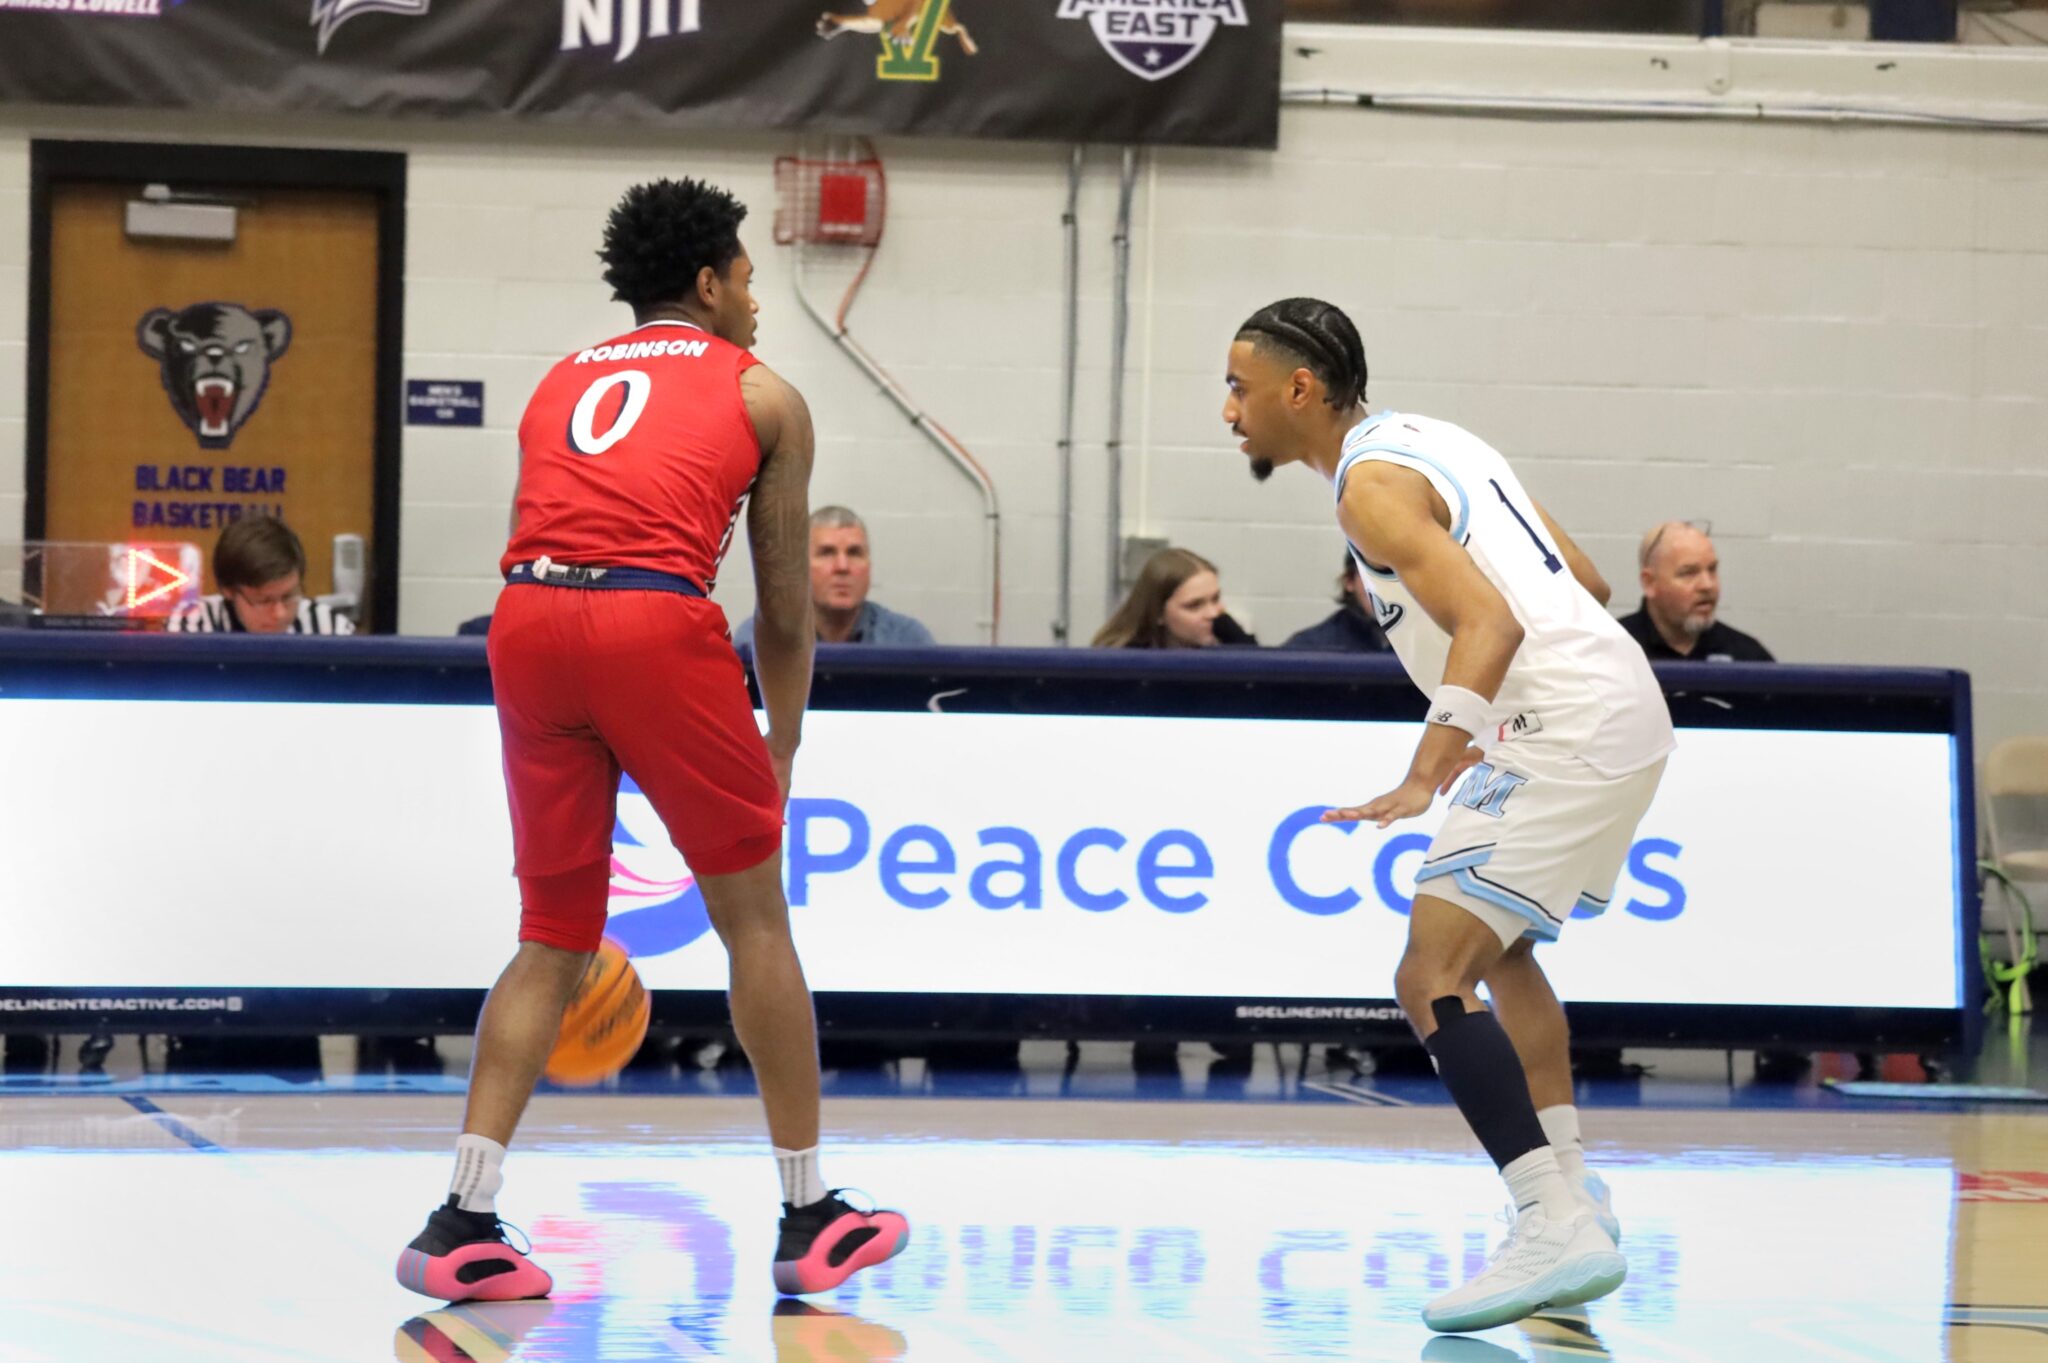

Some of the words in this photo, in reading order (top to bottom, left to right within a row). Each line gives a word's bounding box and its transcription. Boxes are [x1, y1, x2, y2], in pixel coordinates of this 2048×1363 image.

[1106, 10, 1201, 37] EAST
[574, 340, 709, 365] ROBINSON
[566, 369, 651, 456] 0
[136, 465, 213, 491] BLACK
[223, 467, 286, 493] BEAR
[133, 502, 283, 529] BASKETB
[1488, 478, 1563, 575] 1
[1448, 761, 1529, 819] M
[787, 797, 1215, 914] Peace
[1267, 804, 1688, 922] Cos
